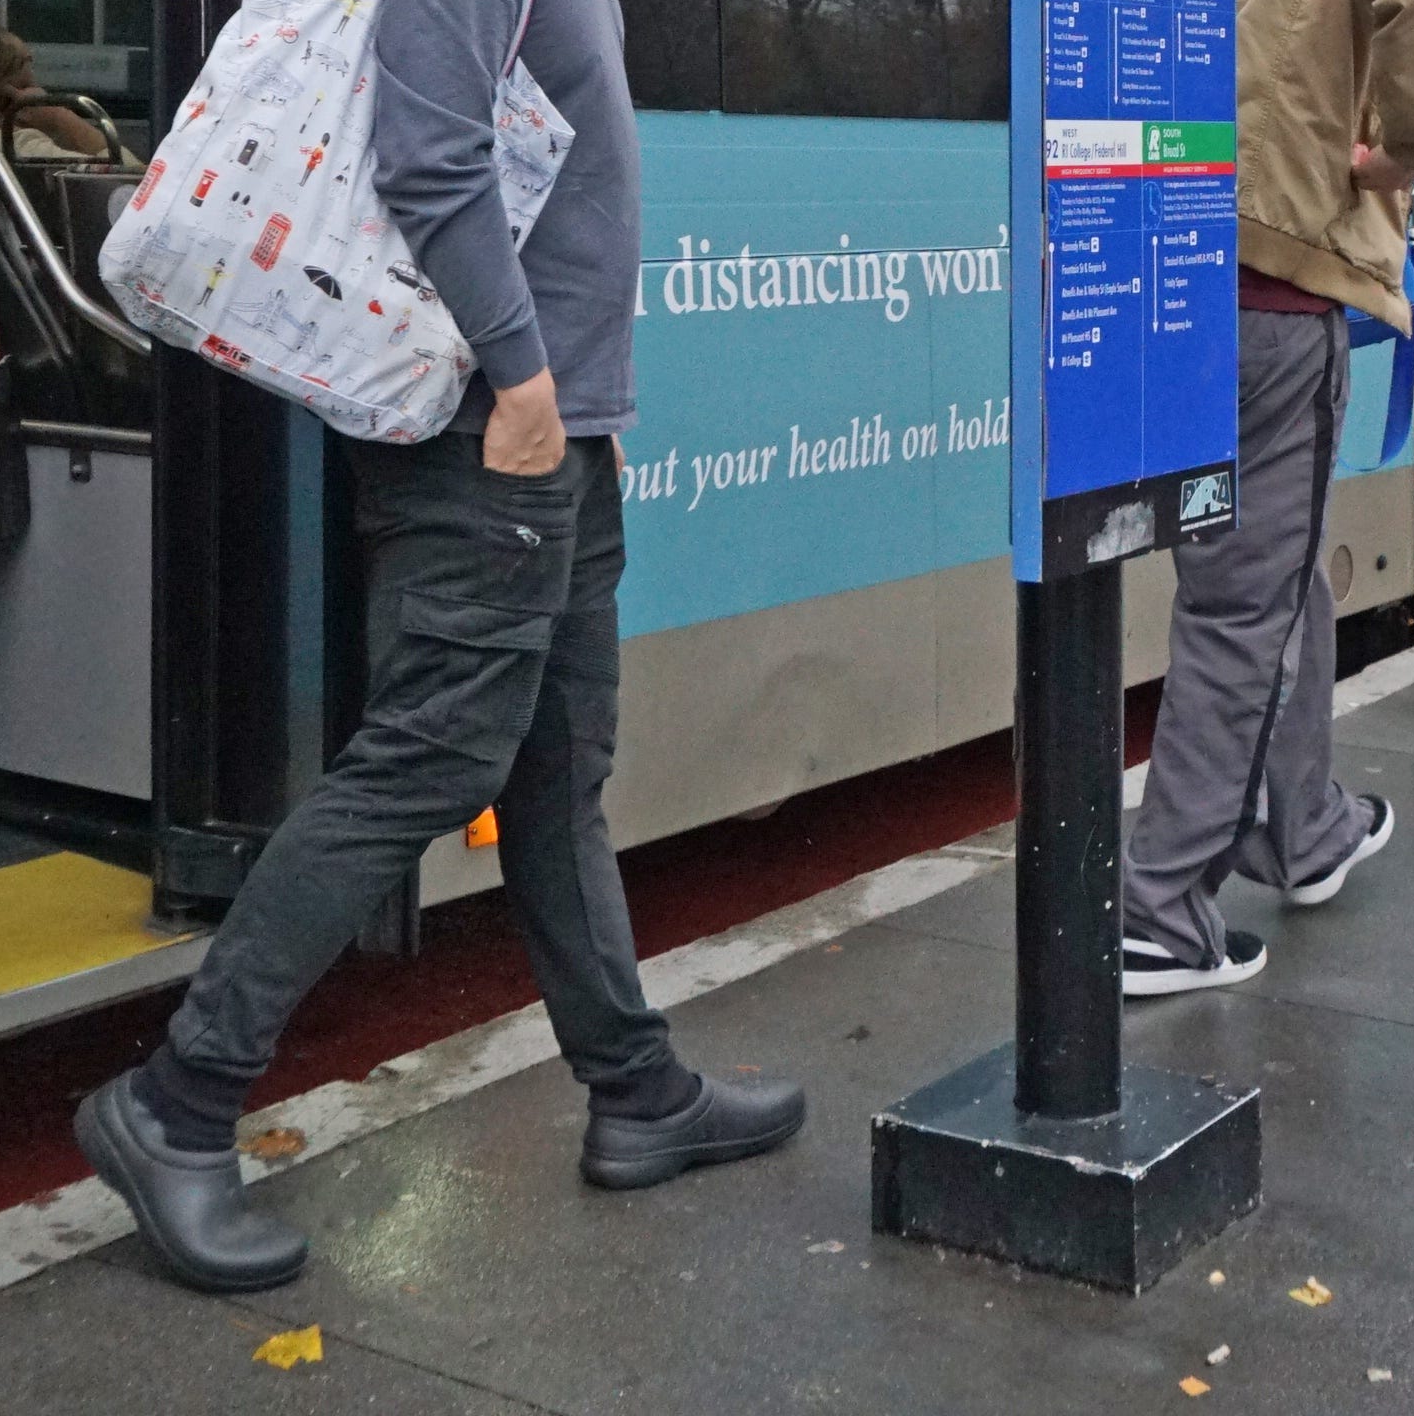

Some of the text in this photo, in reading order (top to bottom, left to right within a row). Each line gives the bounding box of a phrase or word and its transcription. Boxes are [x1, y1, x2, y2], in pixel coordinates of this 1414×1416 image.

[1062, 129, 1077, 138] WEST
[1163, 128, 1182, 138] SOUTH
[1045, 139, 1058, 159] 92
[664, 234, 911, 322] distancing
[919, 224, 1010, 297] won'
[688, 445, 777, 511] your
[789, 413, 891, 479] health
[902, 418, 937, 461] on
[947, 396, 1010, 454] hold
